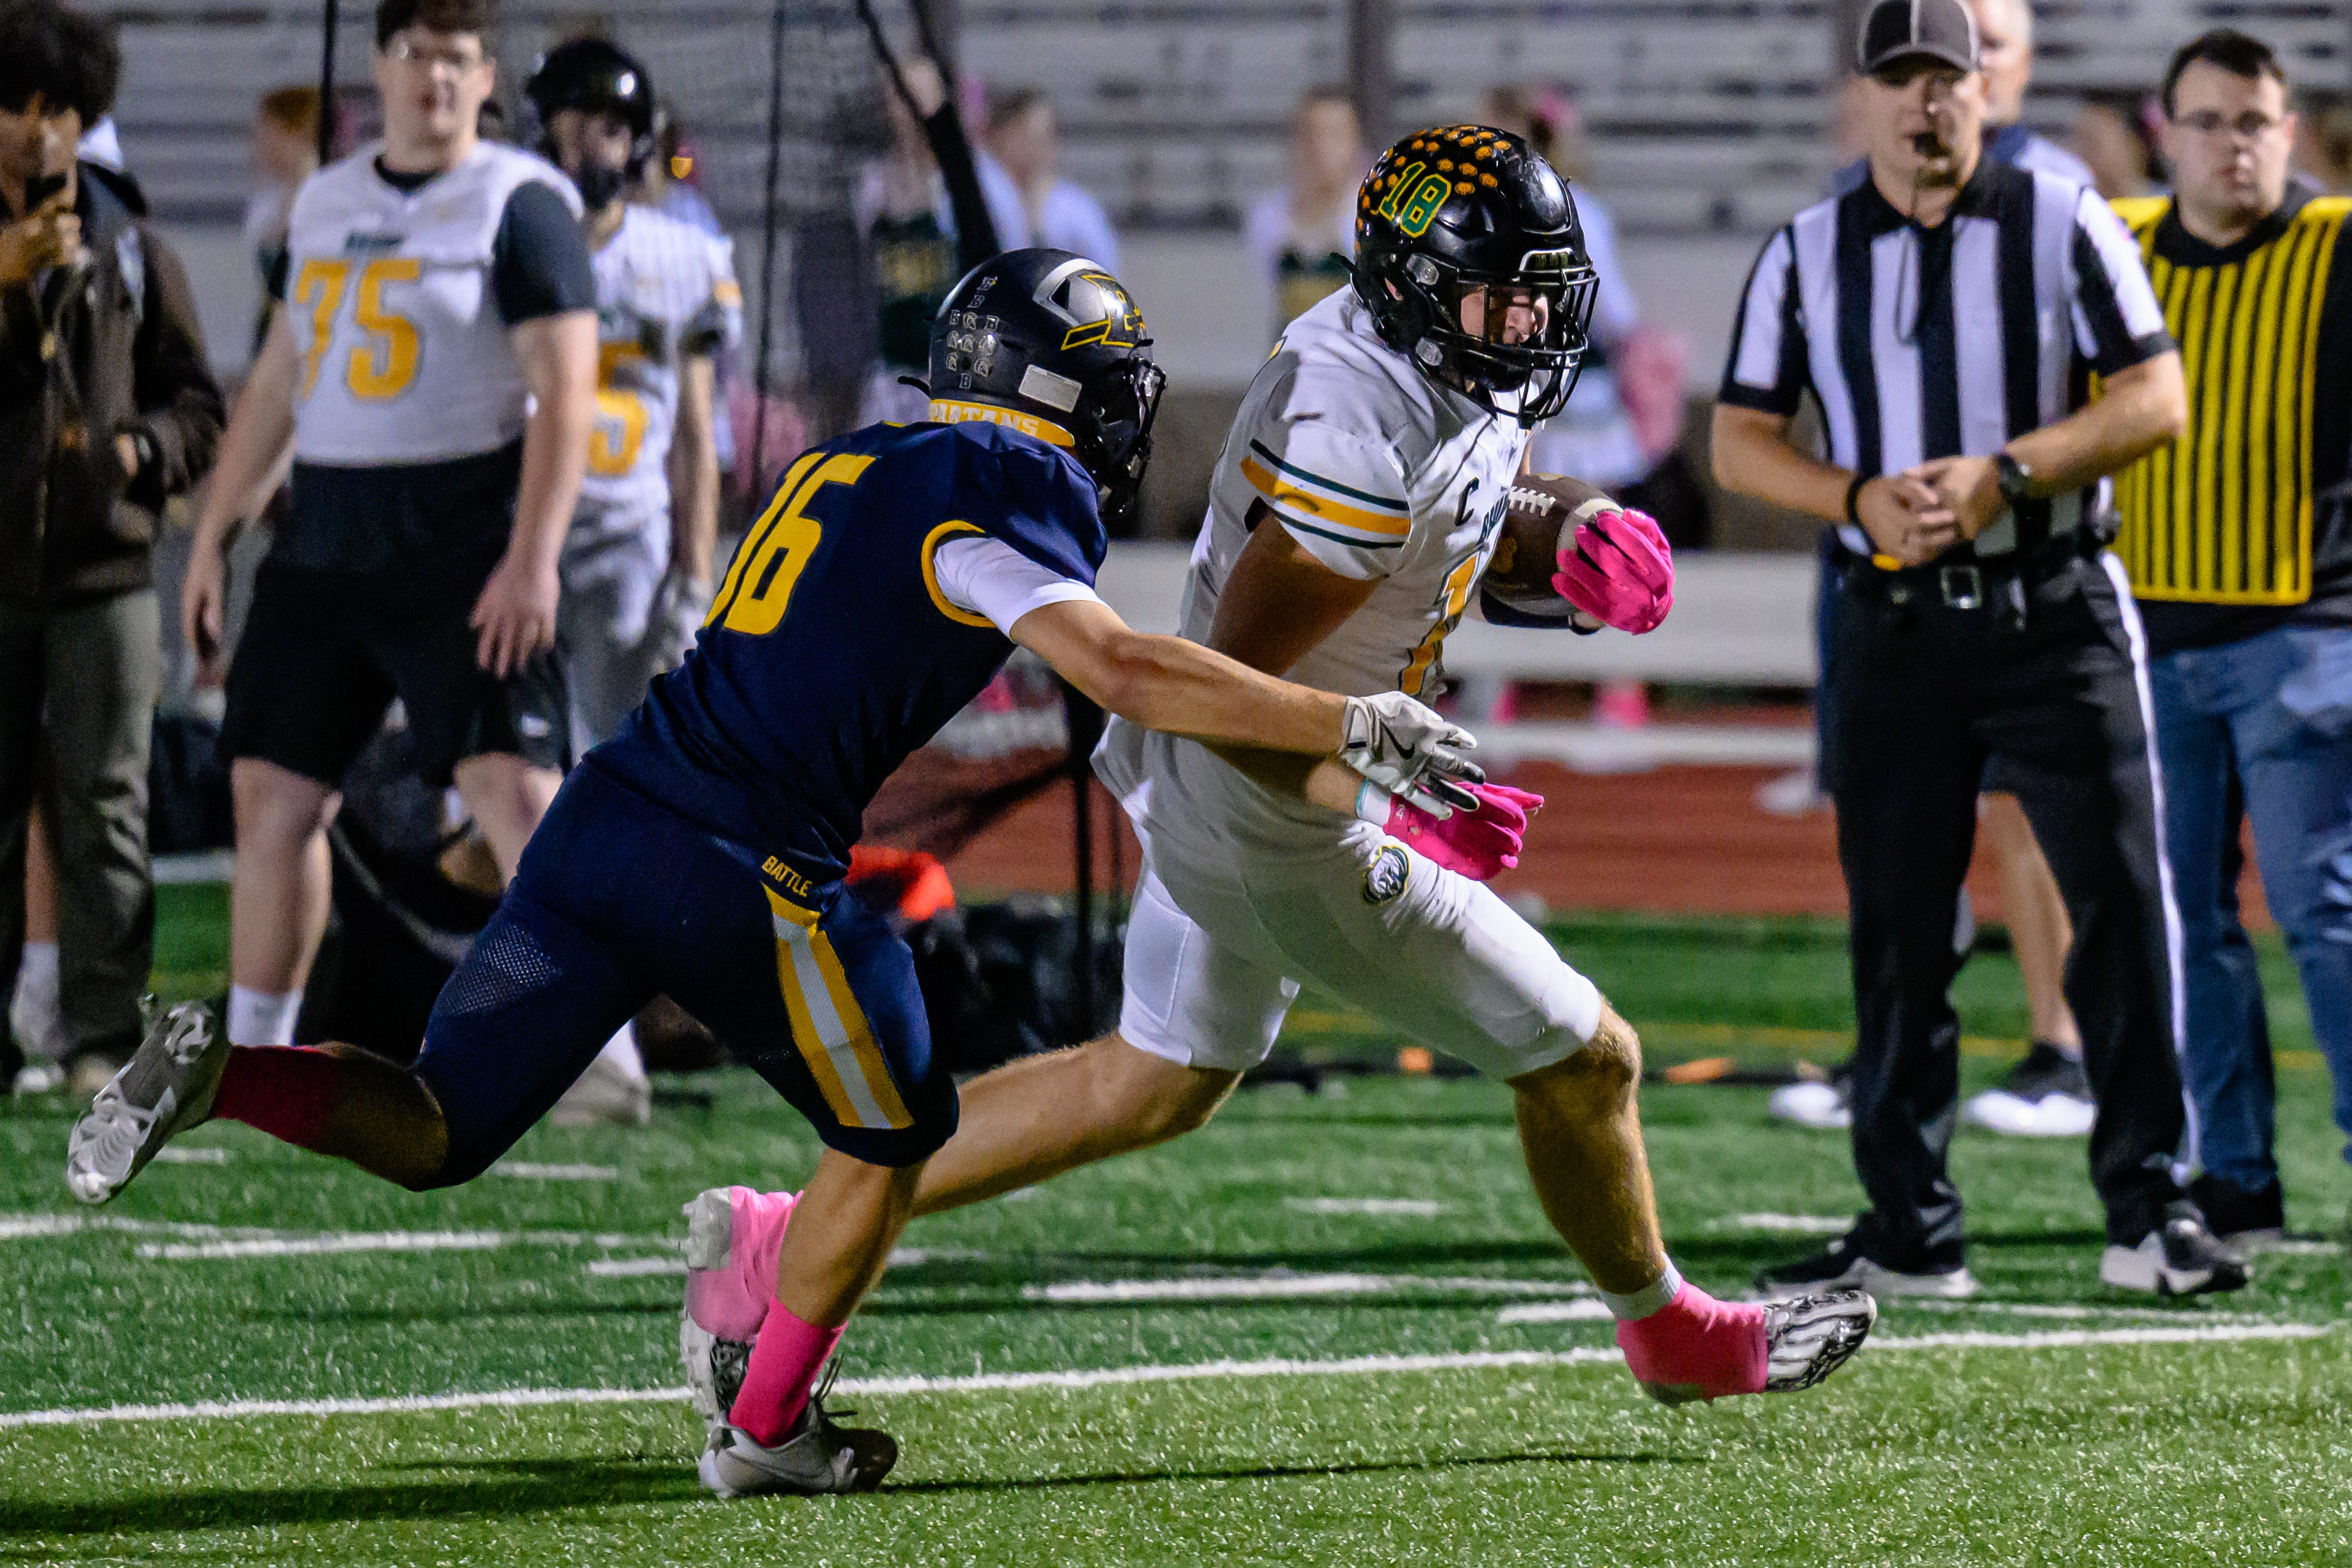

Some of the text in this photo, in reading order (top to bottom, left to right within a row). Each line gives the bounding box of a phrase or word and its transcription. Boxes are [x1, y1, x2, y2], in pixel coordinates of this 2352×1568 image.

[1378, 161, 1452, 238] 18
[296, 259, 421, 399] 75
[703, 452, 876, 635] 16
[1454, 477, 1480, 527] C
[1401, 553, 1481, 694] 1
[761, 855, 812, 898] BATTLE
